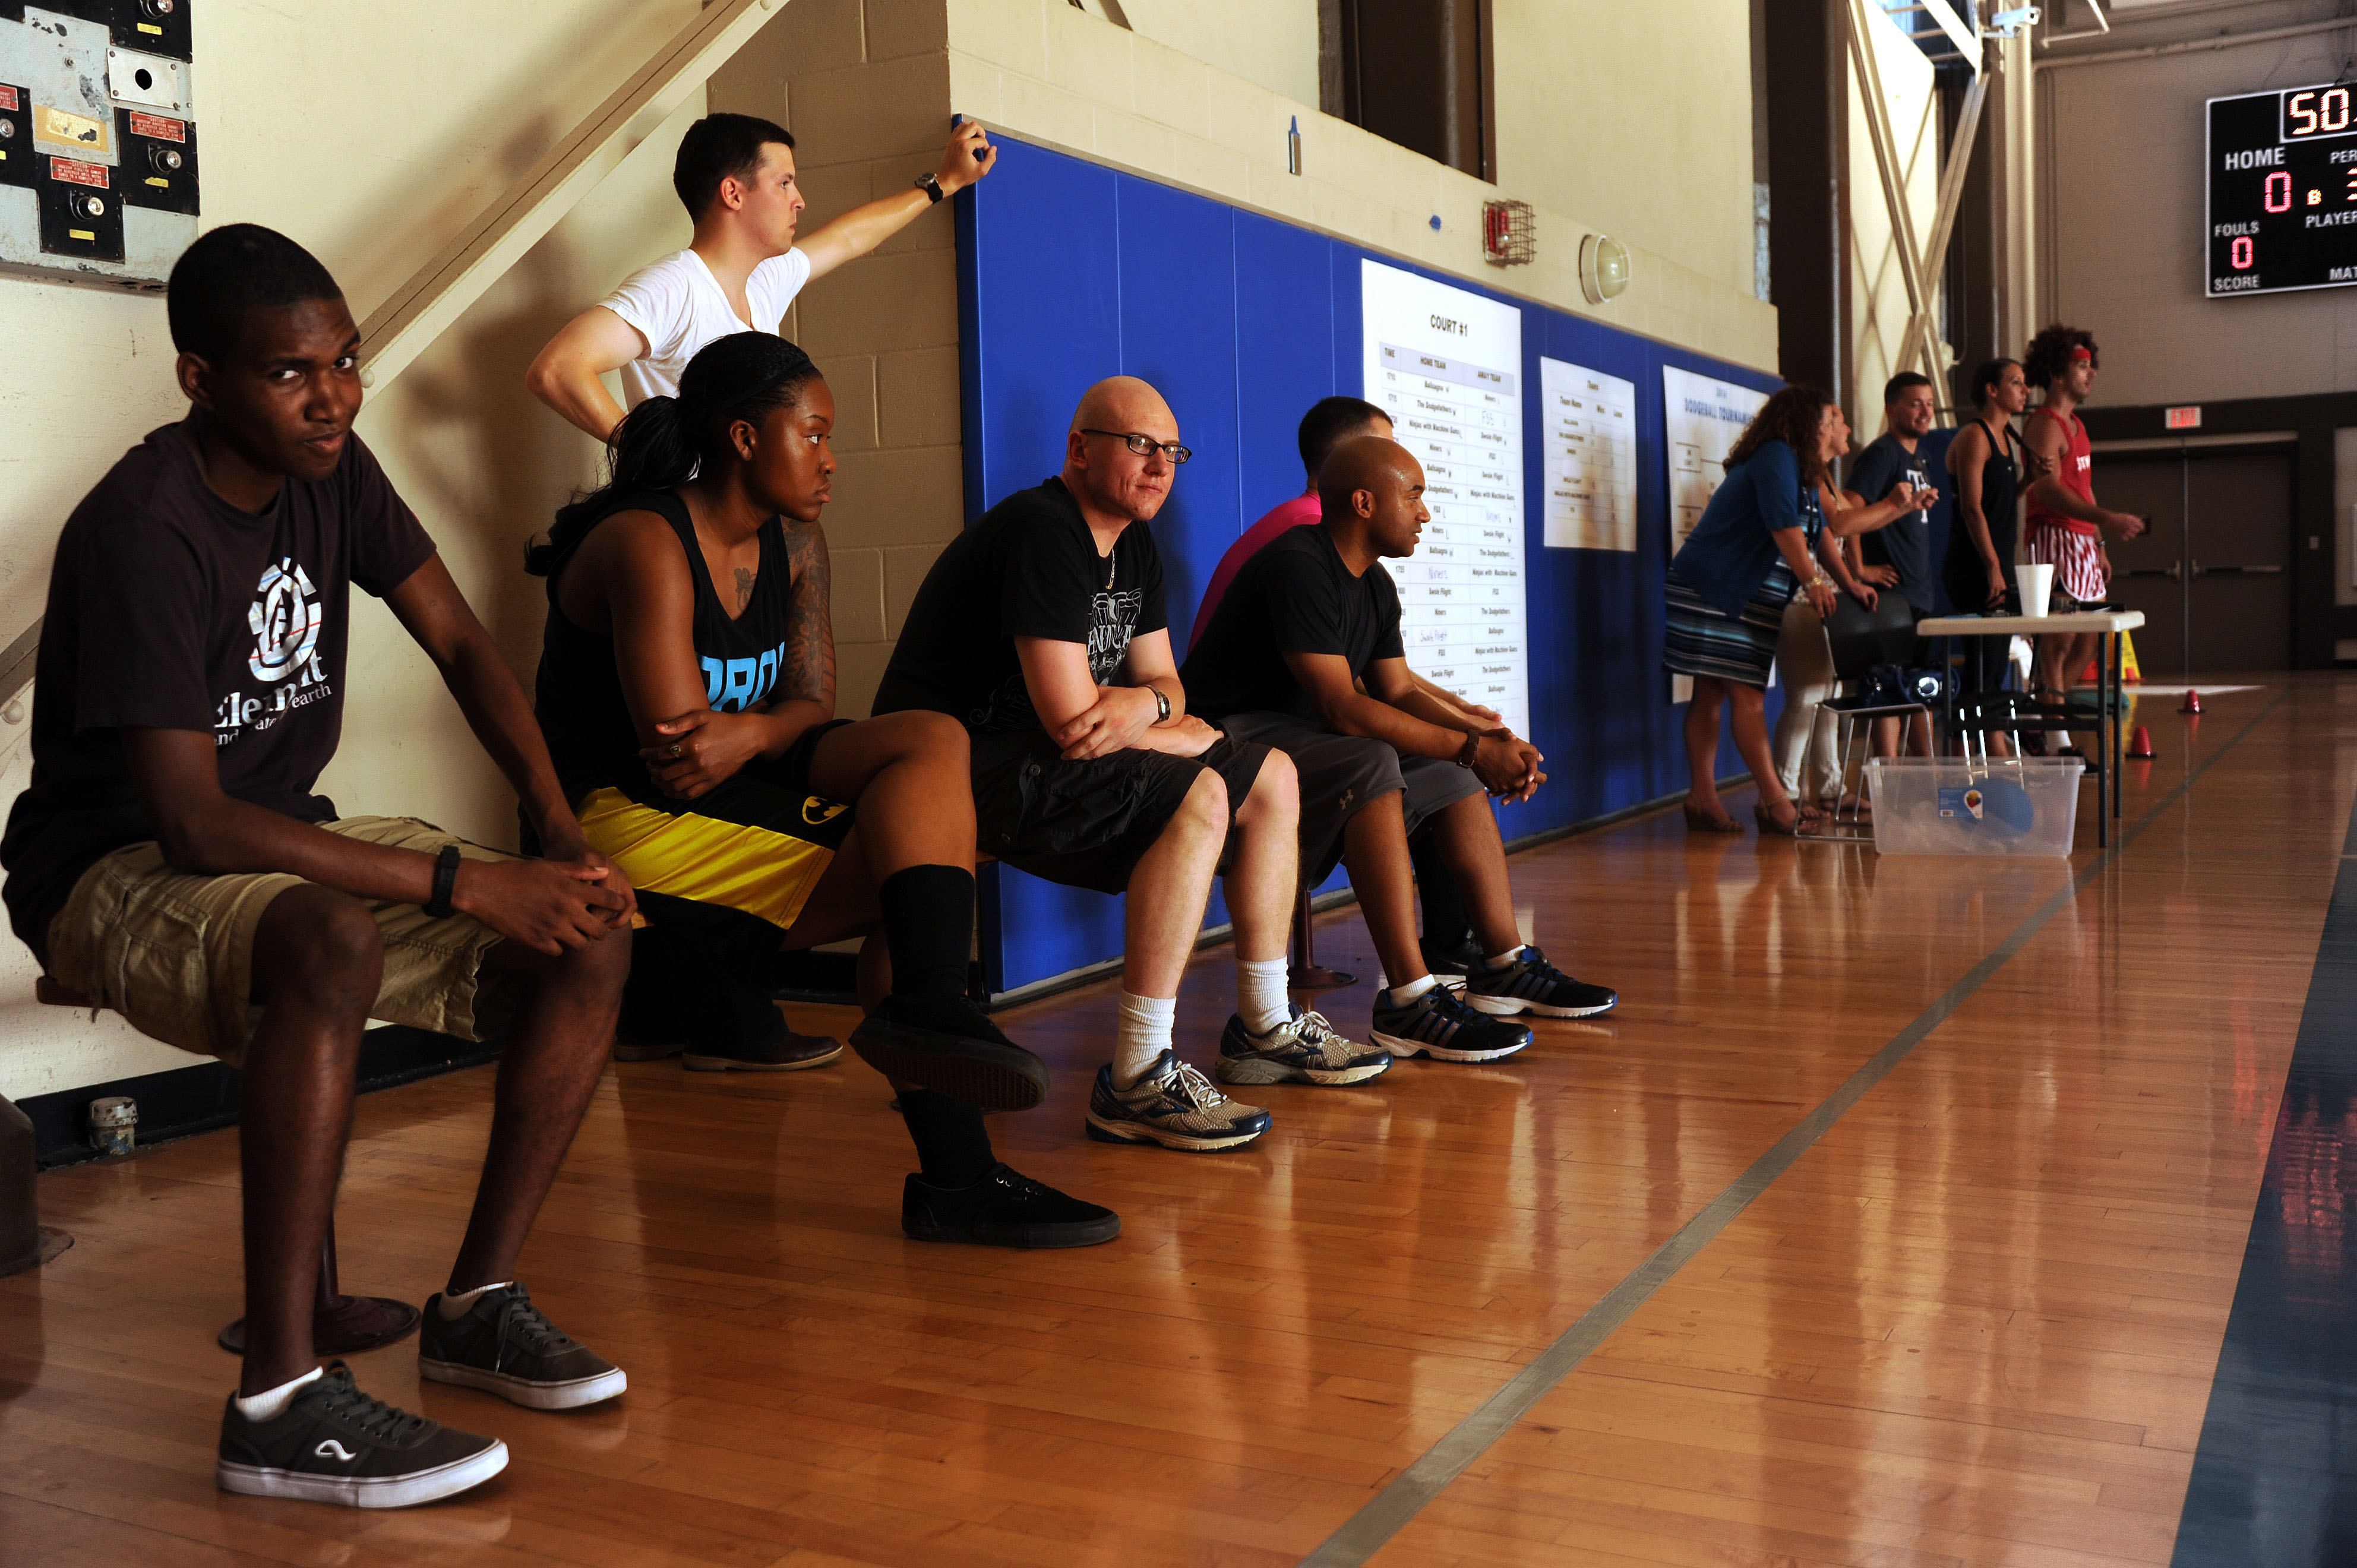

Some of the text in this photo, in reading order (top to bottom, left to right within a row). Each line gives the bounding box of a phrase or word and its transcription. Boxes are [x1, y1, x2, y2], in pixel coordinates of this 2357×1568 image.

[2225, 146, 2286, 170] HOME
[2265, 171, 2291, 213] 0
[2214, 220, 2260, 237] FOULS
[2232, 236, 2253, 269] 0
[2214, 274, 2261, 291] SCORE
[1430, 314, 1468, 337] COURT #1
[1385, 347, 1395, 358] TIME
[1420, 356, 1433, 367] HOME
[1434, 359, 1446, 369] TEAM
[2171, 407, 2196, 428] EXIT
[291, 683, 333, 709] earth
